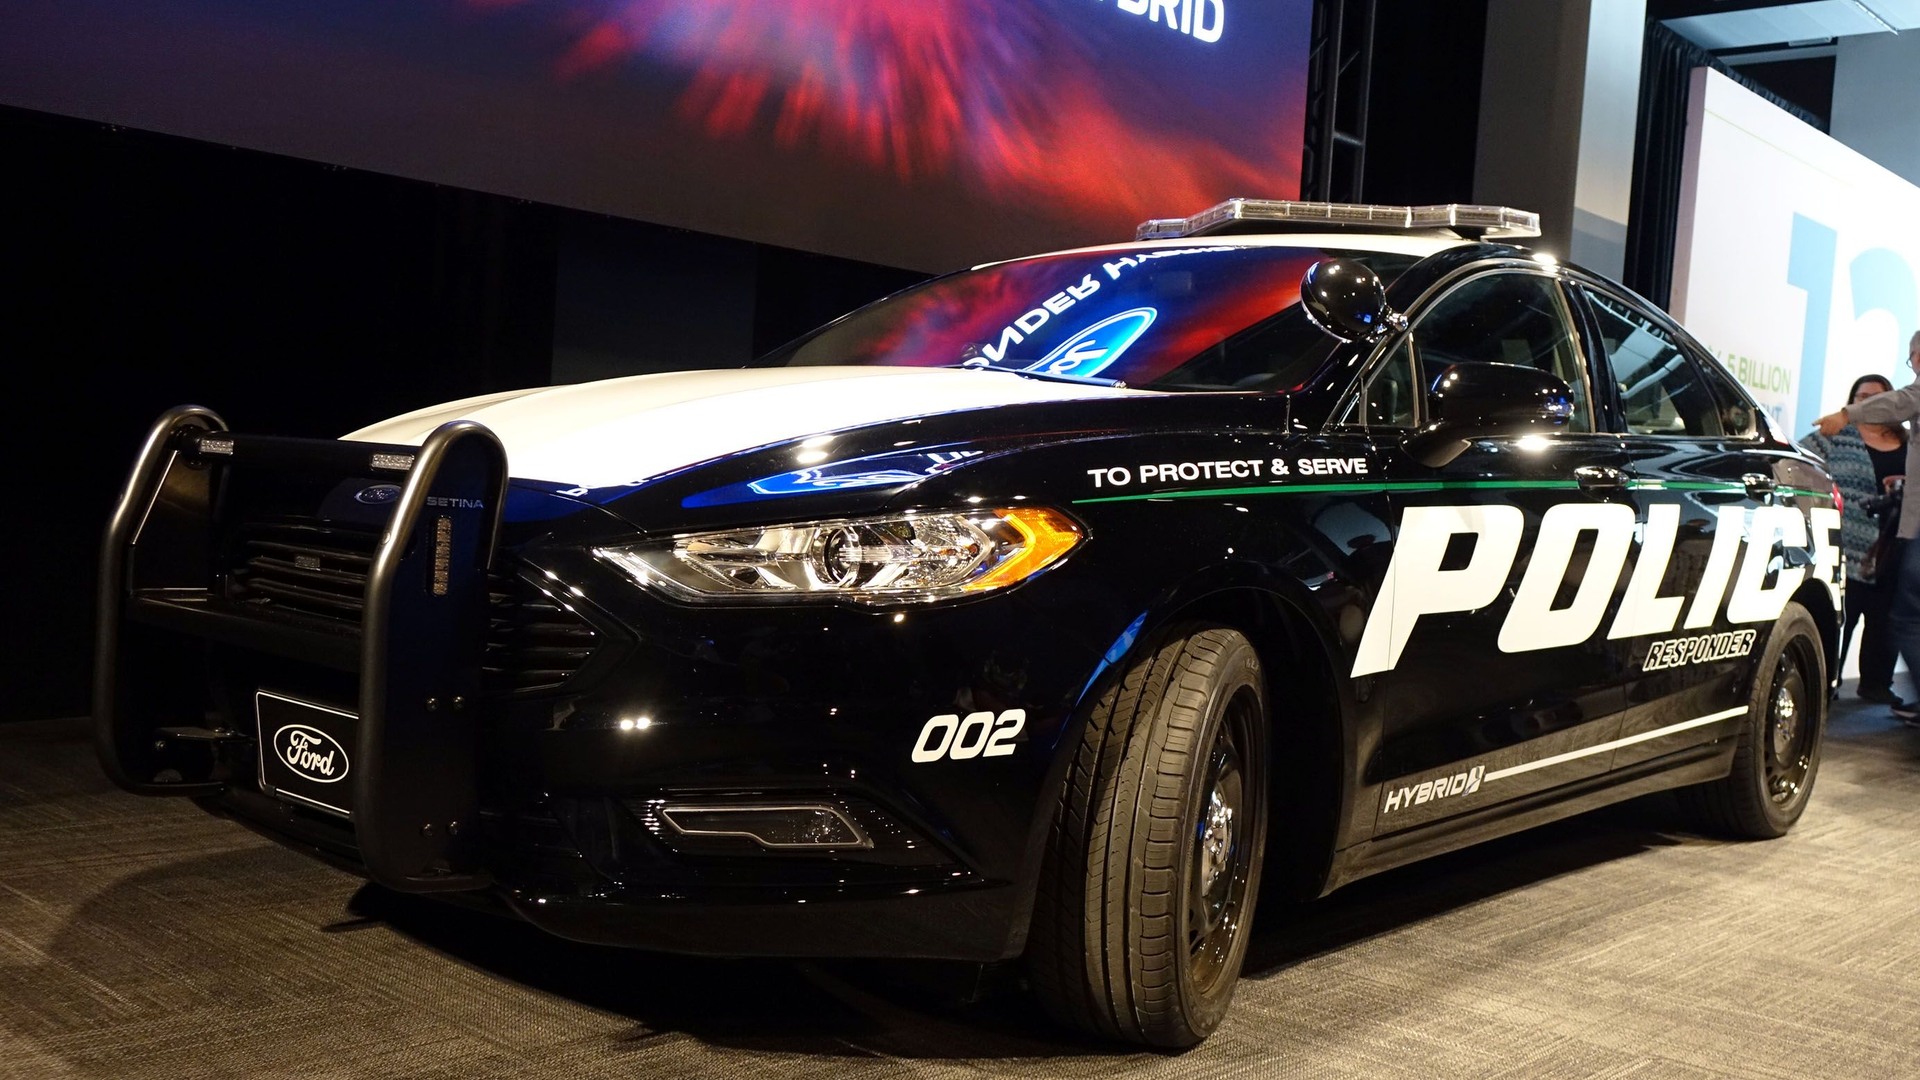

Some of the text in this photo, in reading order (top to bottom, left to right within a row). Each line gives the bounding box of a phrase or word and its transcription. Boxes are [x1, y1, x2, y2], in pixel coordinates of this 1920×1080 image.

[1737, 356, 1792, 395] BILLION
[1087, 457, 1369, 488] TO PROTECT & SERVE
[426, 496, 484, 509] SETINA
[1350, 503, 1843, 678] POLICE
[1642, 629, 1757, 672] RESPONDER
[287, 730, 335, 776] Ford
[911, 708, 1026, 763] 002
[1383, 772, 1468, 814] HYBRID
